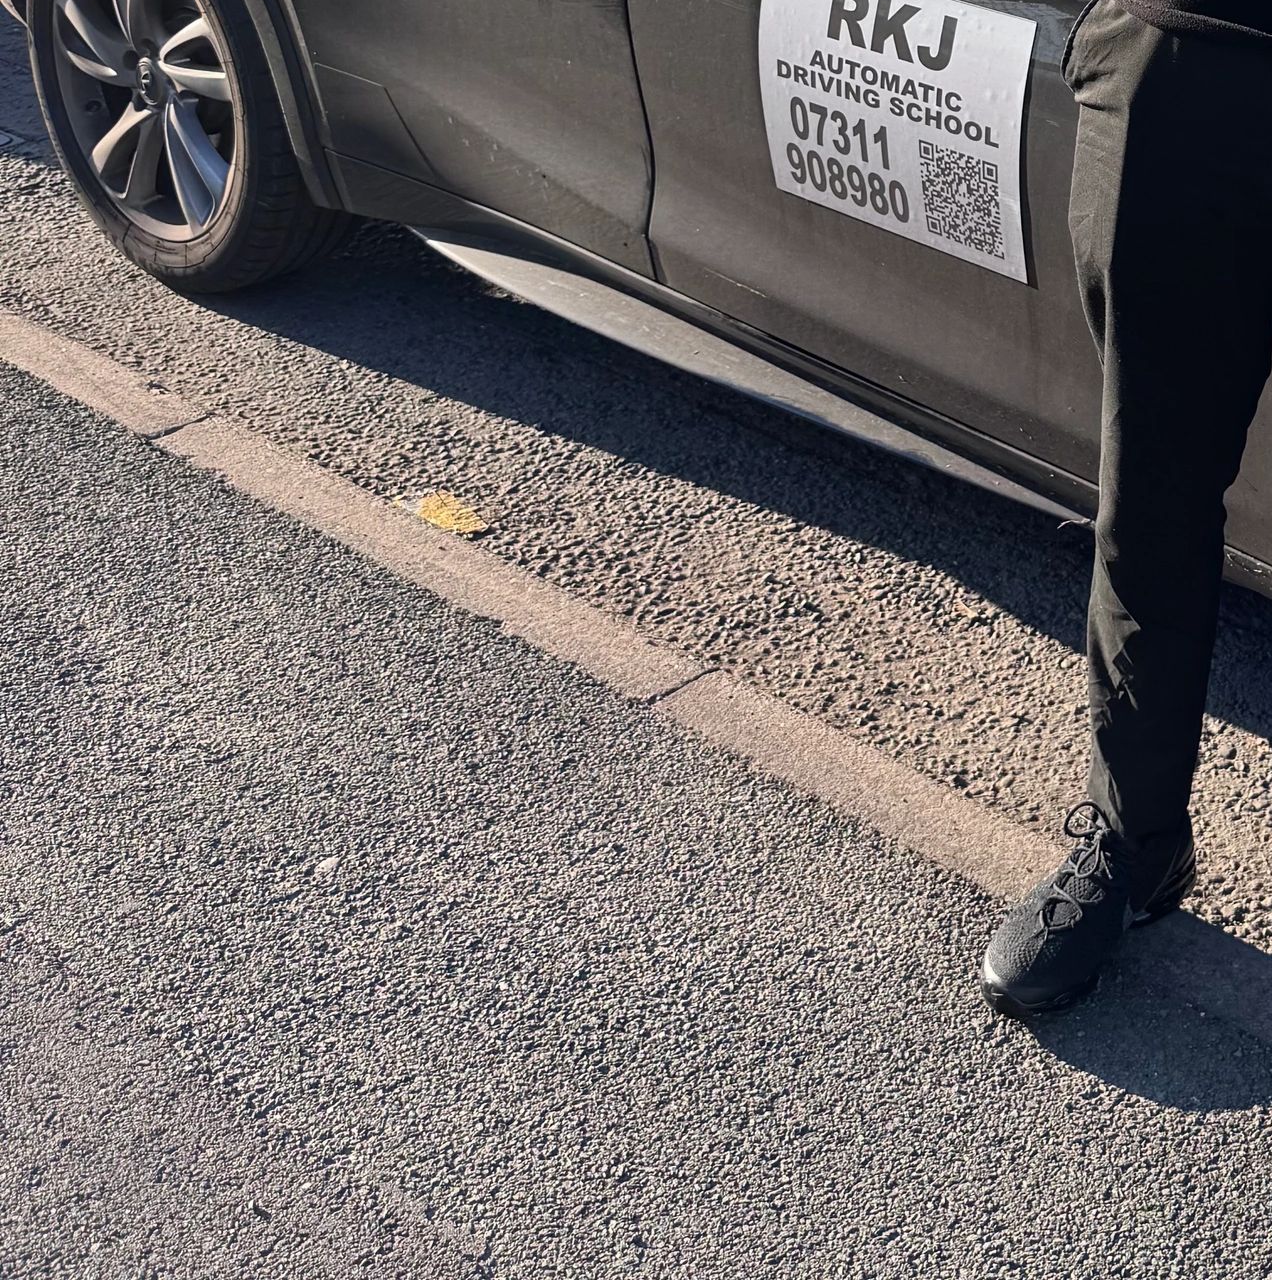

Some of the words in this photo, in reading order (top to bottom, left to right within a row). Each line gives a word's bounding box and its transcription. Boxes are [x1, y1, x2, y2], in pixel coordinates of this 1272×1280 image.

[777, 59, 881, 108] DRIVING
[889, 97, 1000, 148] SCHOOL
[809, 50, 963, 112] AUTOMATIC
[790, 96, 890, 171] 07311
[786, 142, 910, 223] 908980
